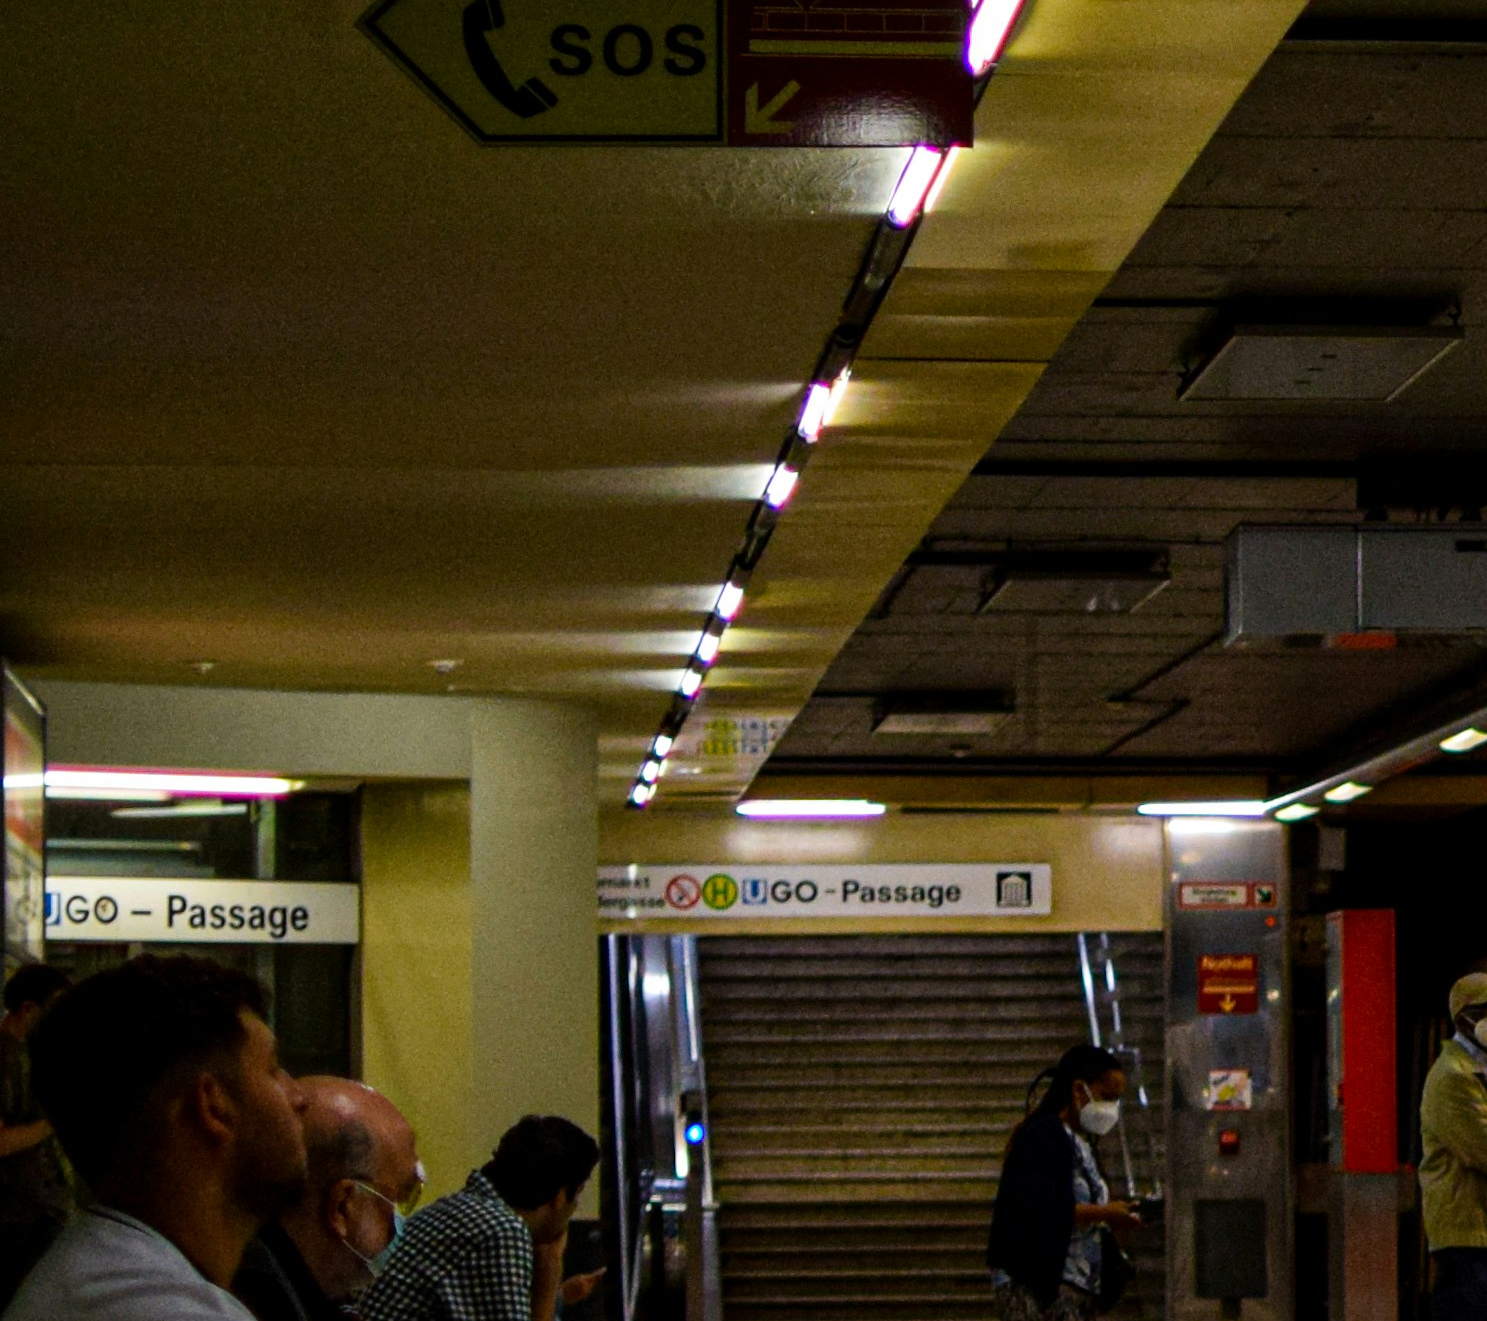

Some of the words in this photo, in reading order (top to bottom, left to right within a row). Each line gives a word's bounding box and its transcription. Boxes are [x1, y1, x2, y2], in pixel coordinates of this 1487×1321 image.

[548, 22, 707, 77] SOS
[842, 879, 962, 906] Passage
[167, 895, 309, 938] Passage
